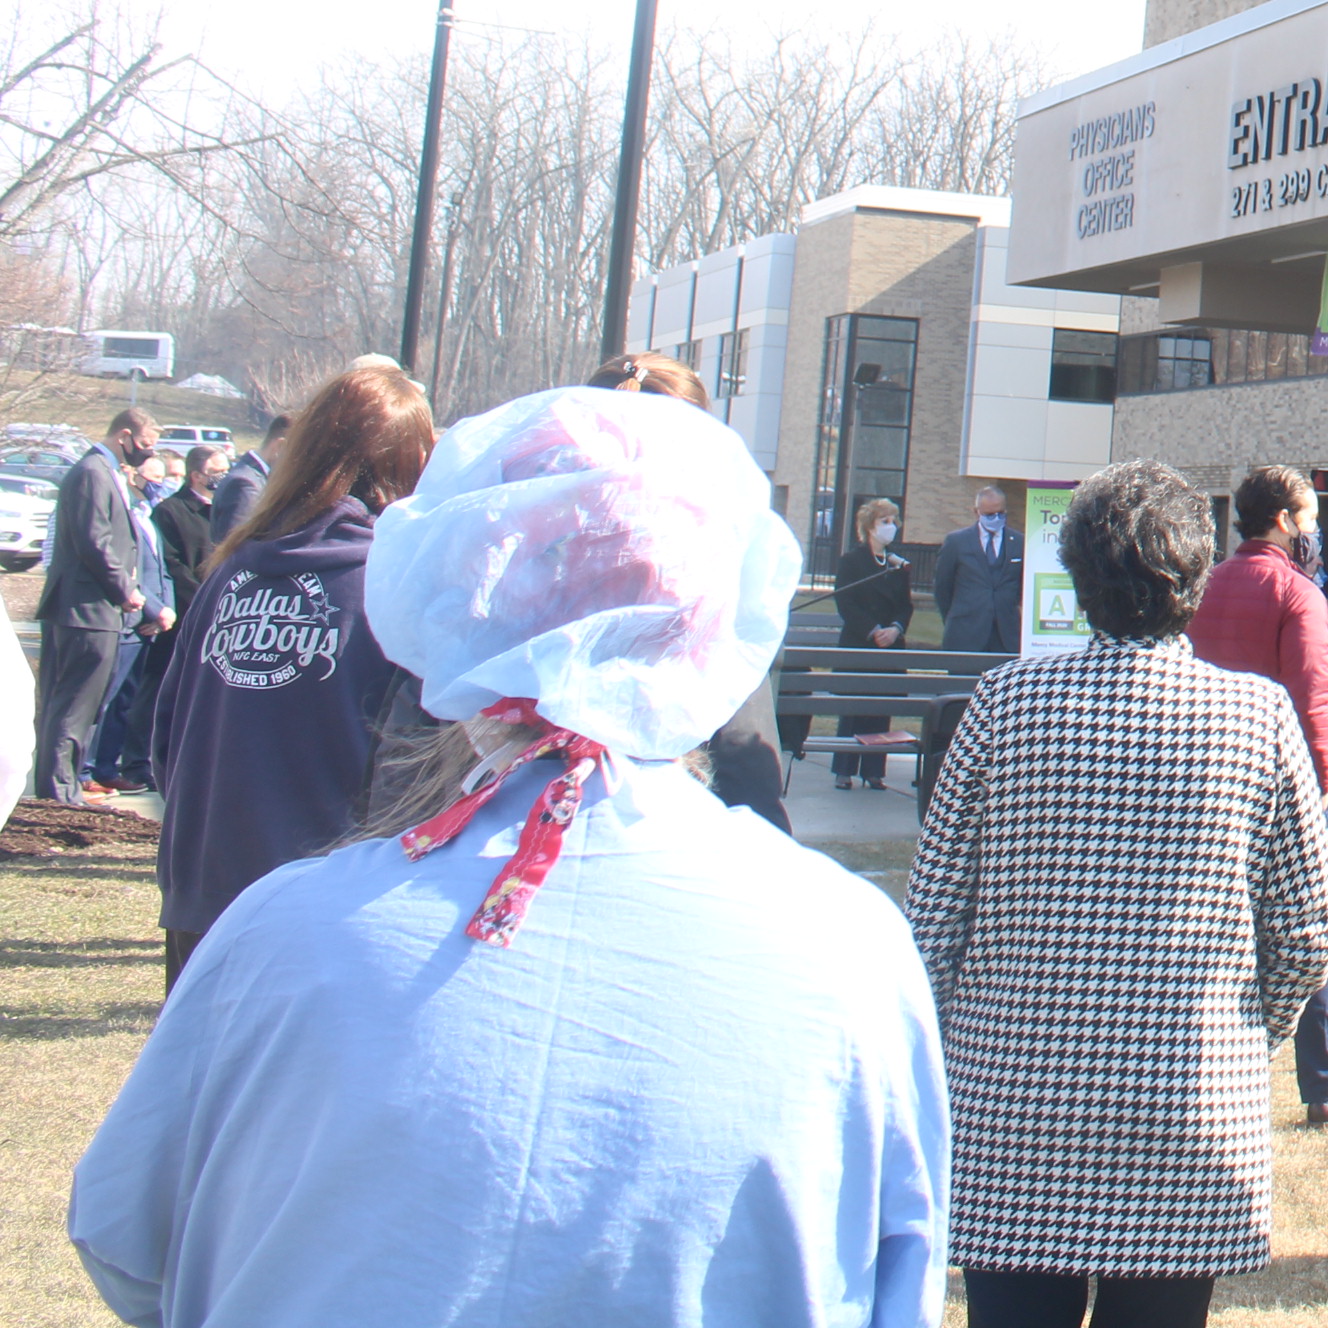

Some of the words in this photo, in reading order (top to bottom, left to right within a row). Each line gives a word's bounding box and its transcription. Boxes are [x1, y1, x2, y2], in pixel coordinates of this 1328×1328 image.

[1069, 101, 1156, 161] PHYSICIANS
[1083, 149, 1135, 198] OFFICE
[1231, 181, 1258, 218] 271
[1261, 178, 1273, 212] &
[1278, 168, 1311, 208] 299
[1076, 193, 1135, 241] CENTER
[1033, 495, 1073, 507] MERC
[294, 571, 323, 598] EAM
[218, 588, 311, 624] Dallas
[1048, 593, 1066, 616] A
[201, 614, 339, 682] Cowboys
[232, 651, 250, 661] NFC
[251, 652, 281, 663] EAST
[270, 664, 297, 686] 1960
